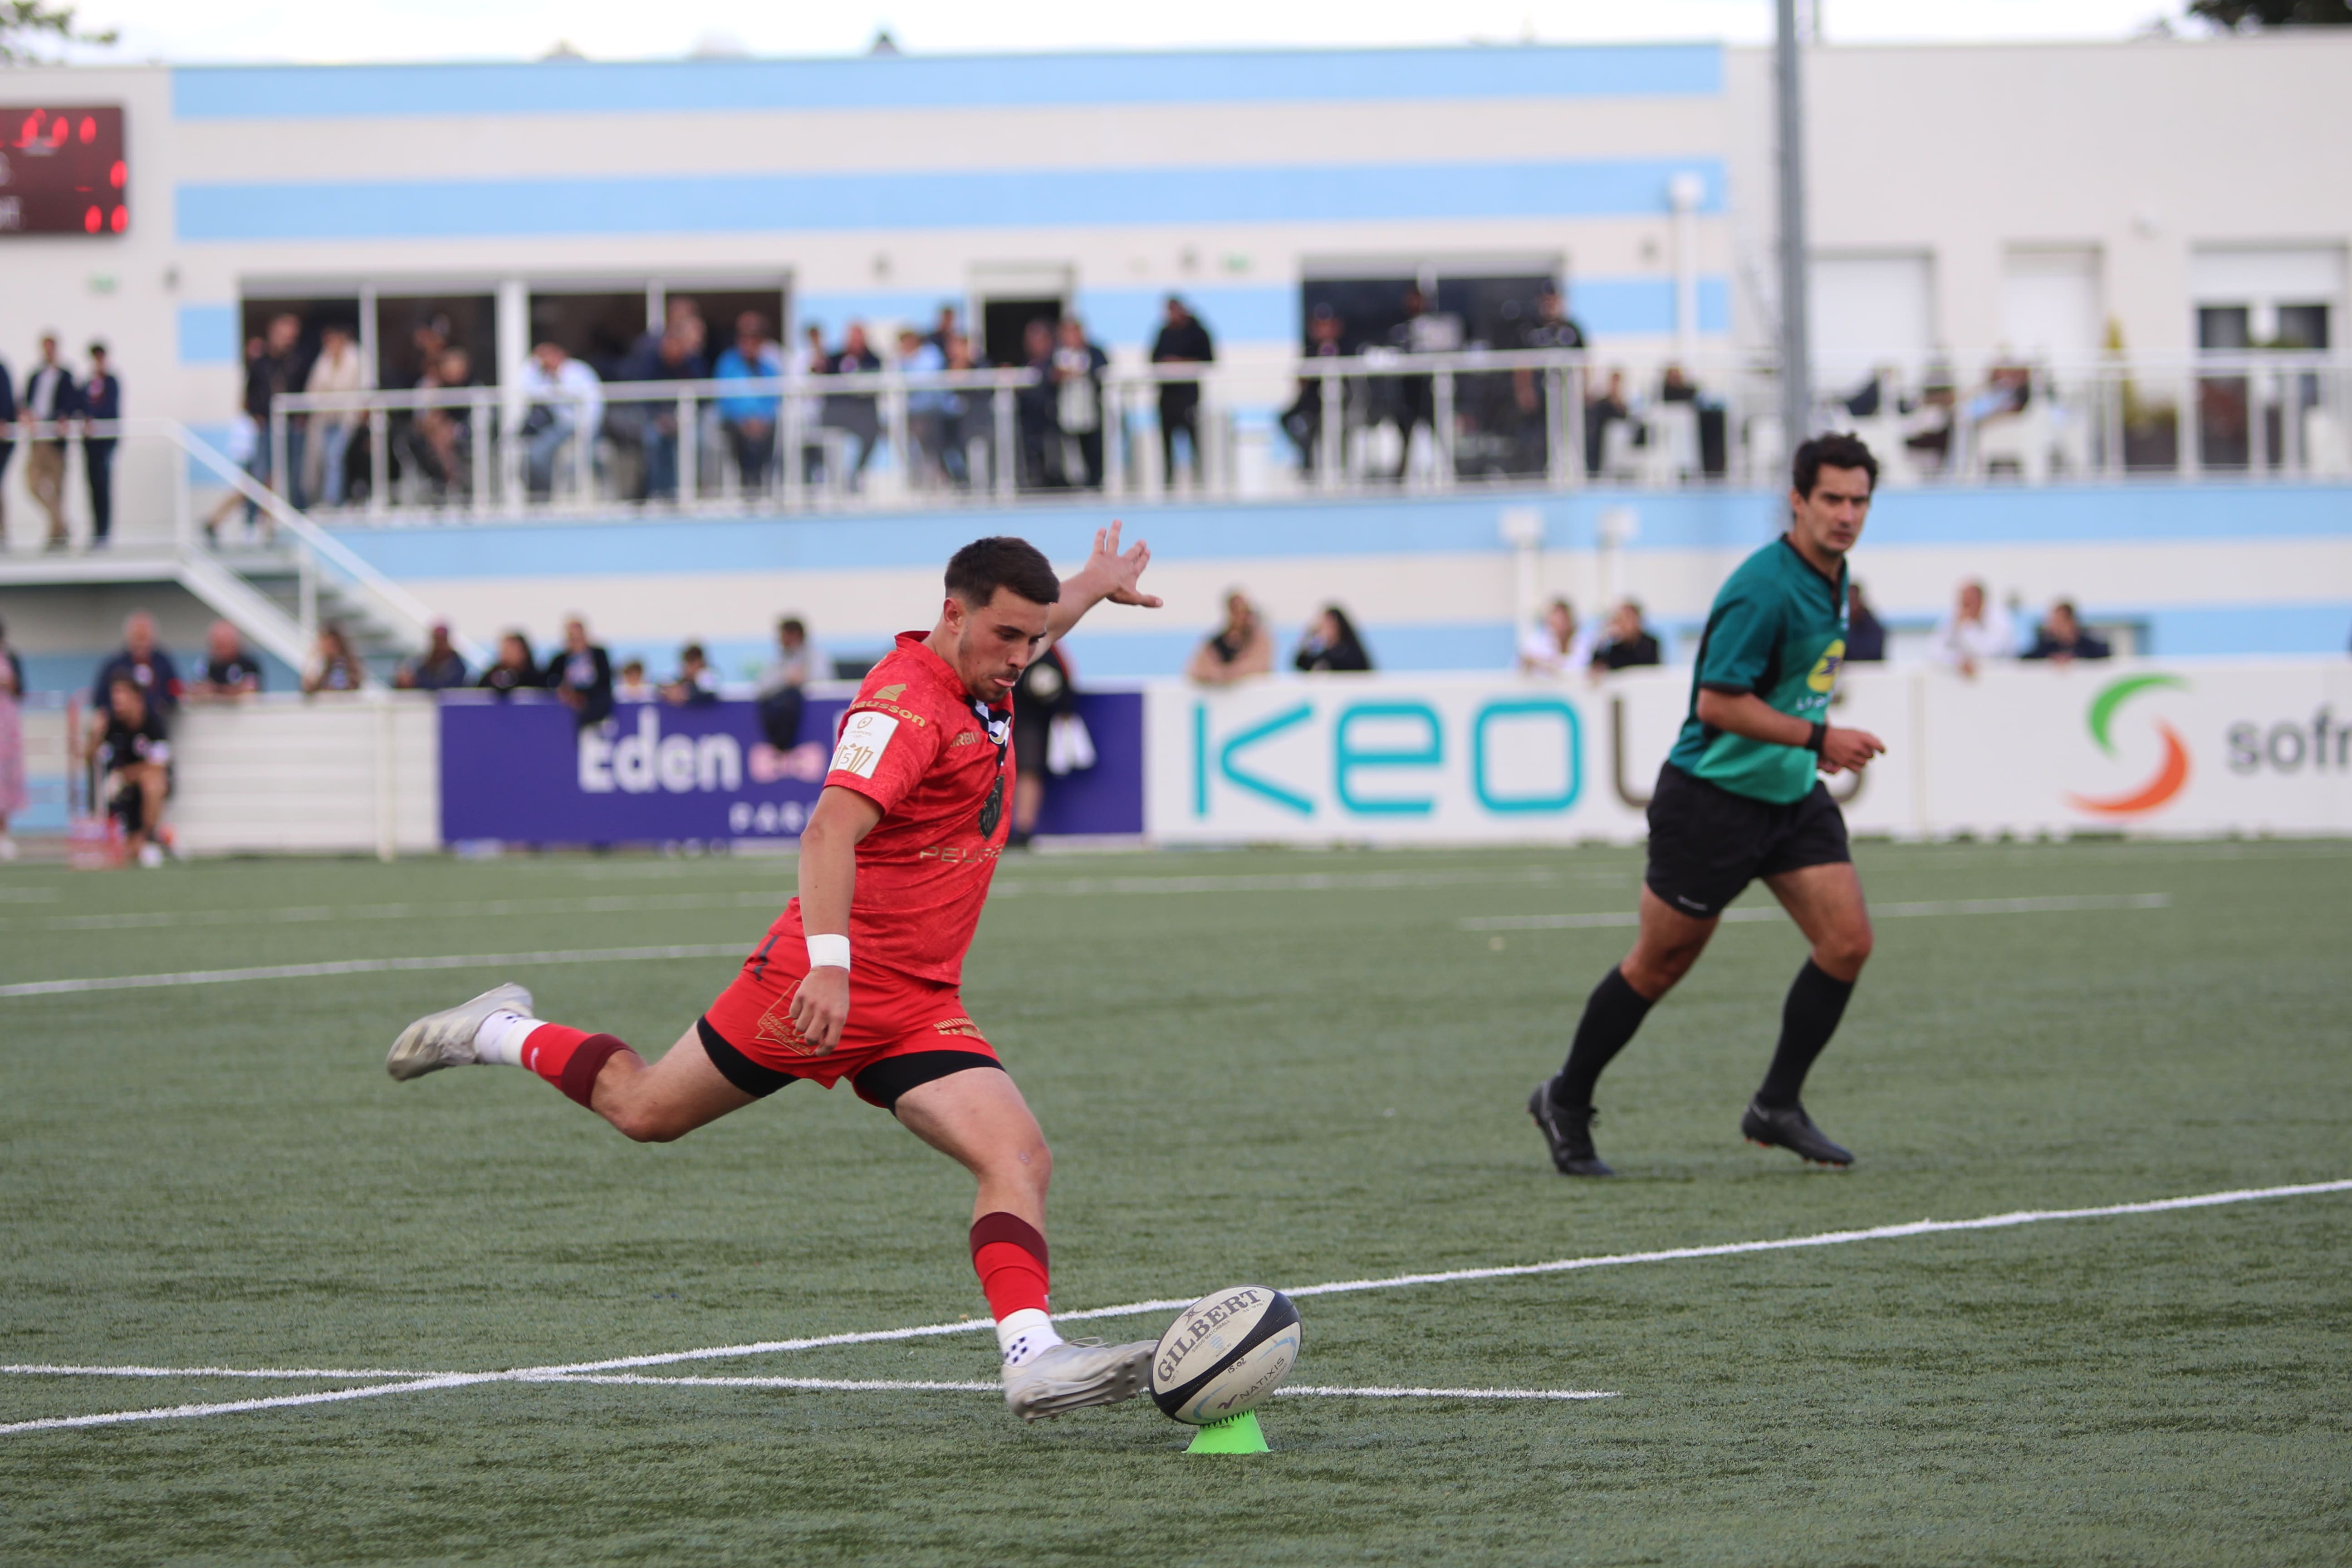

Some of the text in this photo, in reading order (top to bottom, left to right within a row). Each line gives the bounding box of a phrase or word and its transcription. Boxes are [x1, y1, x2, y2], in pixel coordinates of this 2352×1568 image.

[577, 704, 743, 794] Eden
[1157, 1289, 1261, 1382] GILBERT
[1191, 1319, 1231, 1353] SIRIUS MATCHBALL
[1227, 1357, 1247, 1374] 15.02
[1240, 1357, 1284, 1399] NATIXIS
